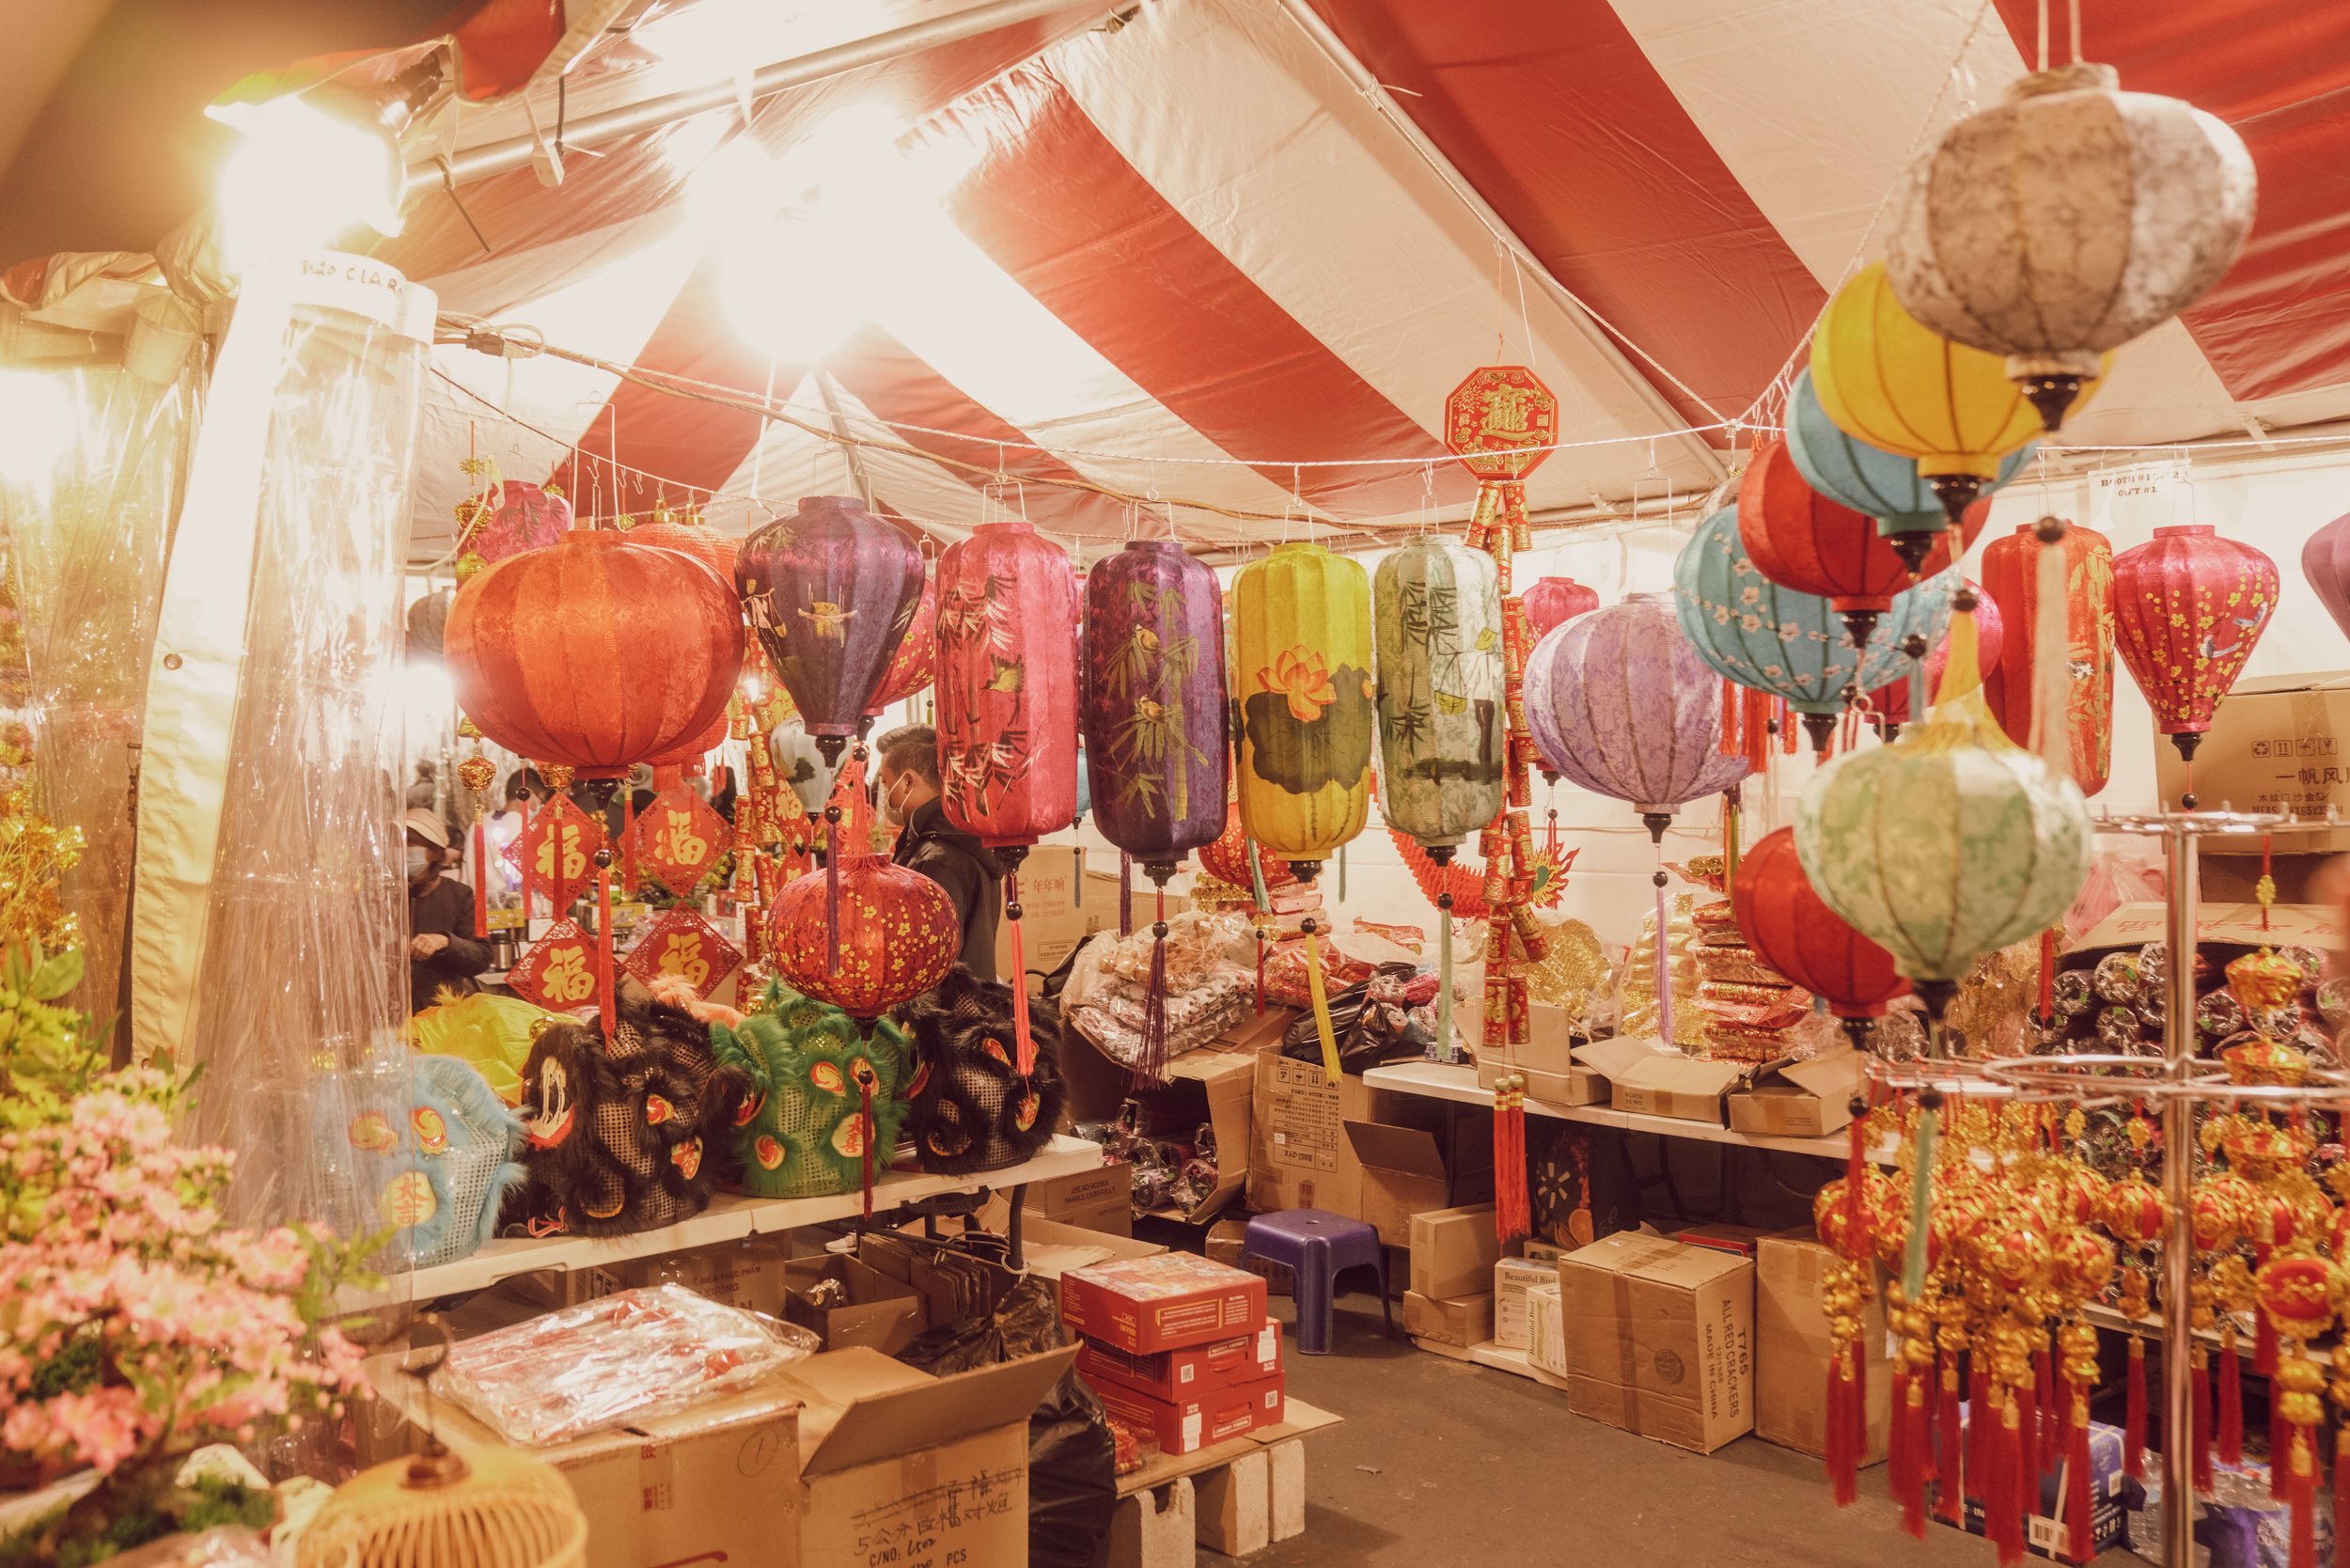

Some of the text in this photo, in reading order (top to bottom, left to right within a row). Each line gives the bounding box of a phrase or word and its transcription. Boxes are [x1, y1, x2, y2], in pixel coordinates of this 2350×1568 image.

[535, 823, 587, 880] 福
[654, 809, 708, 866] 福
[542, 945, 596, 1003] 福
[658, 932, 711, 987] 福
[1504, 1272, 1557, 1284] Beautiful Bird
[1706, 1323, 1718, 1419] MADE IN CHINA
[1722, 1299, 1740, 1419] ALL RED CRACKERS
[1738, 1325, 1748, 1375] T765
[947, 1548, 967, 1566] PCS
